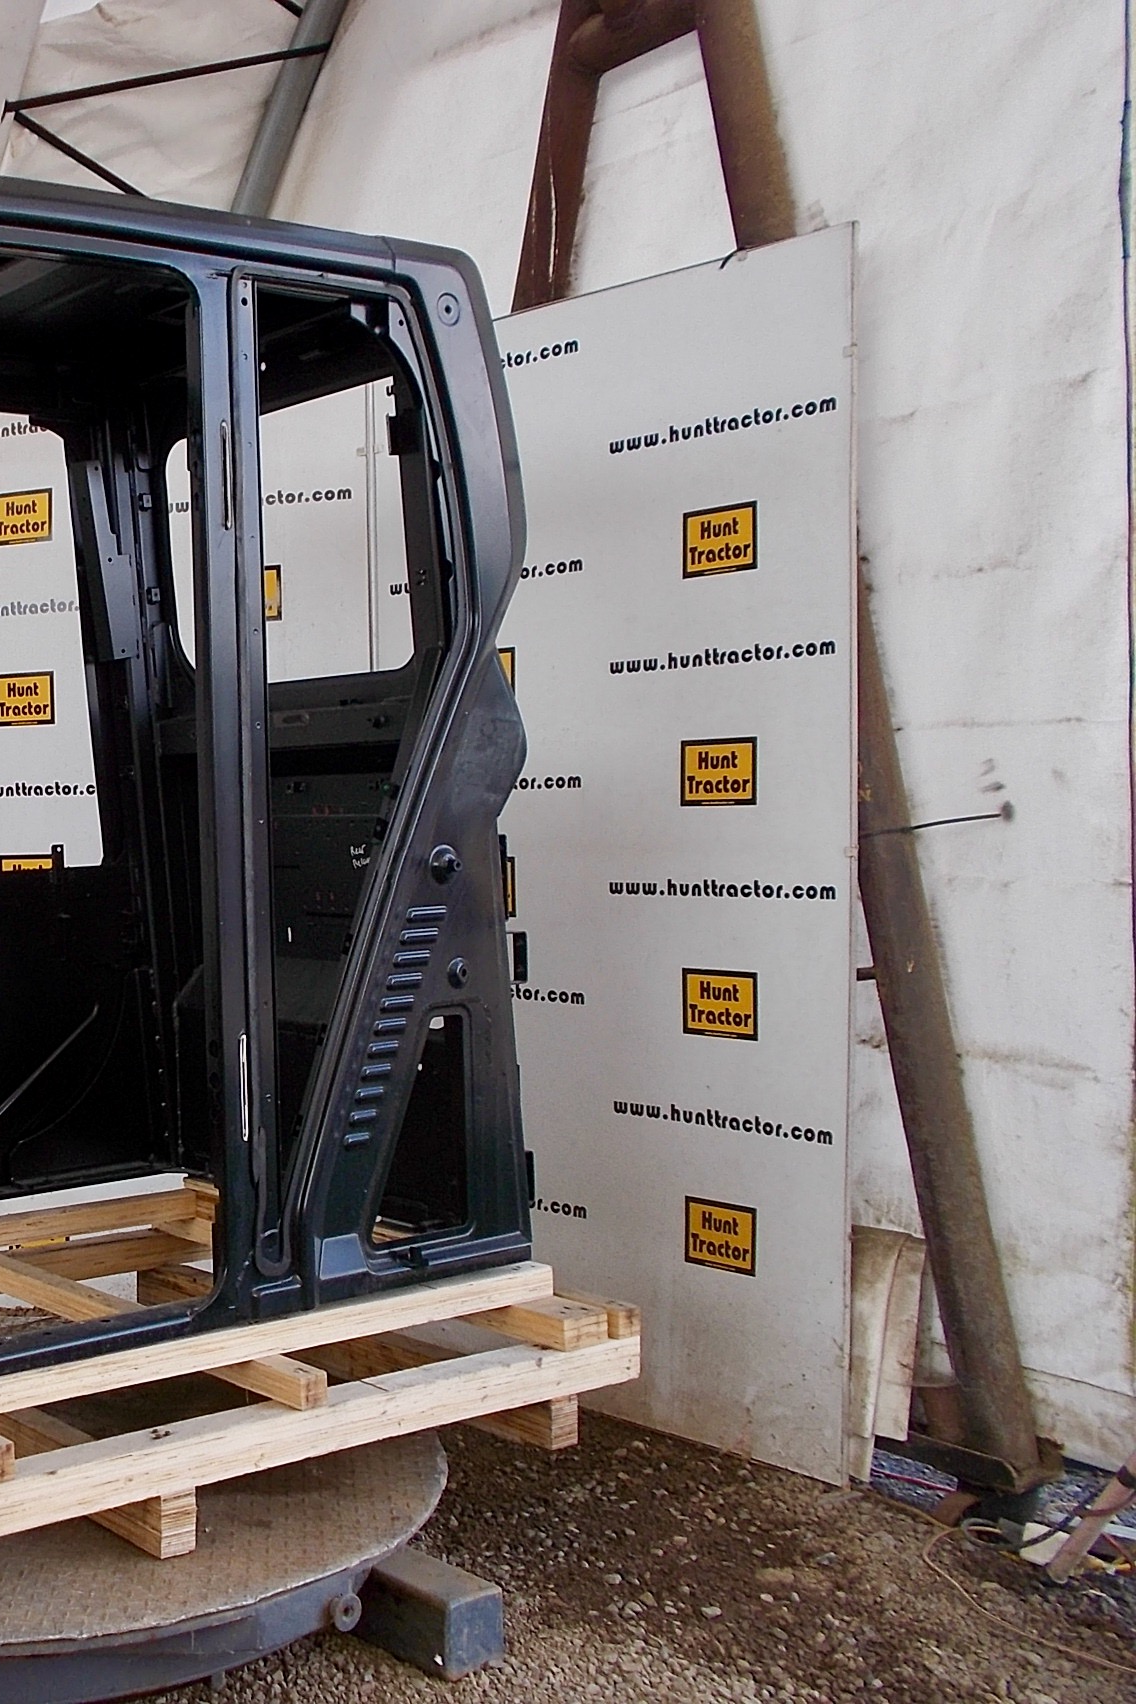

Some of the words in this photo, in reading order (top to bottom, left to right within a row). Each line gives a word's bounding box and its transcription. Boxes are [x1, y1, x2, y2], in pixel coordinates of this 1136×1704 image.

[610, 398, 836, 454] www.hunttractor.com
[6, 500, 37, 516] Hunt
[701, 517, 738, 540] Hunt
[689, 542, 751, 565] Tractor
[610, 641, 835, 674] www.hunttractor.com
[8, 682, 38, 697] Hunt
[0, 702, 49, 717] Tractor
[698, 751, 737, 770] Hunt
[687, 776, 750, 794] Tractor
[609, 879, 835, 899] www.hunttractor.com
[700, 981, 739, 1002] Hunt
[689, 1004, 751, 1027] Tractor
[614, 1101, 832, 1145] www.hunttractor.com
[701, 1210, 739, 1235] Hunt
[691, 1232, 750, 1262] Tractor
